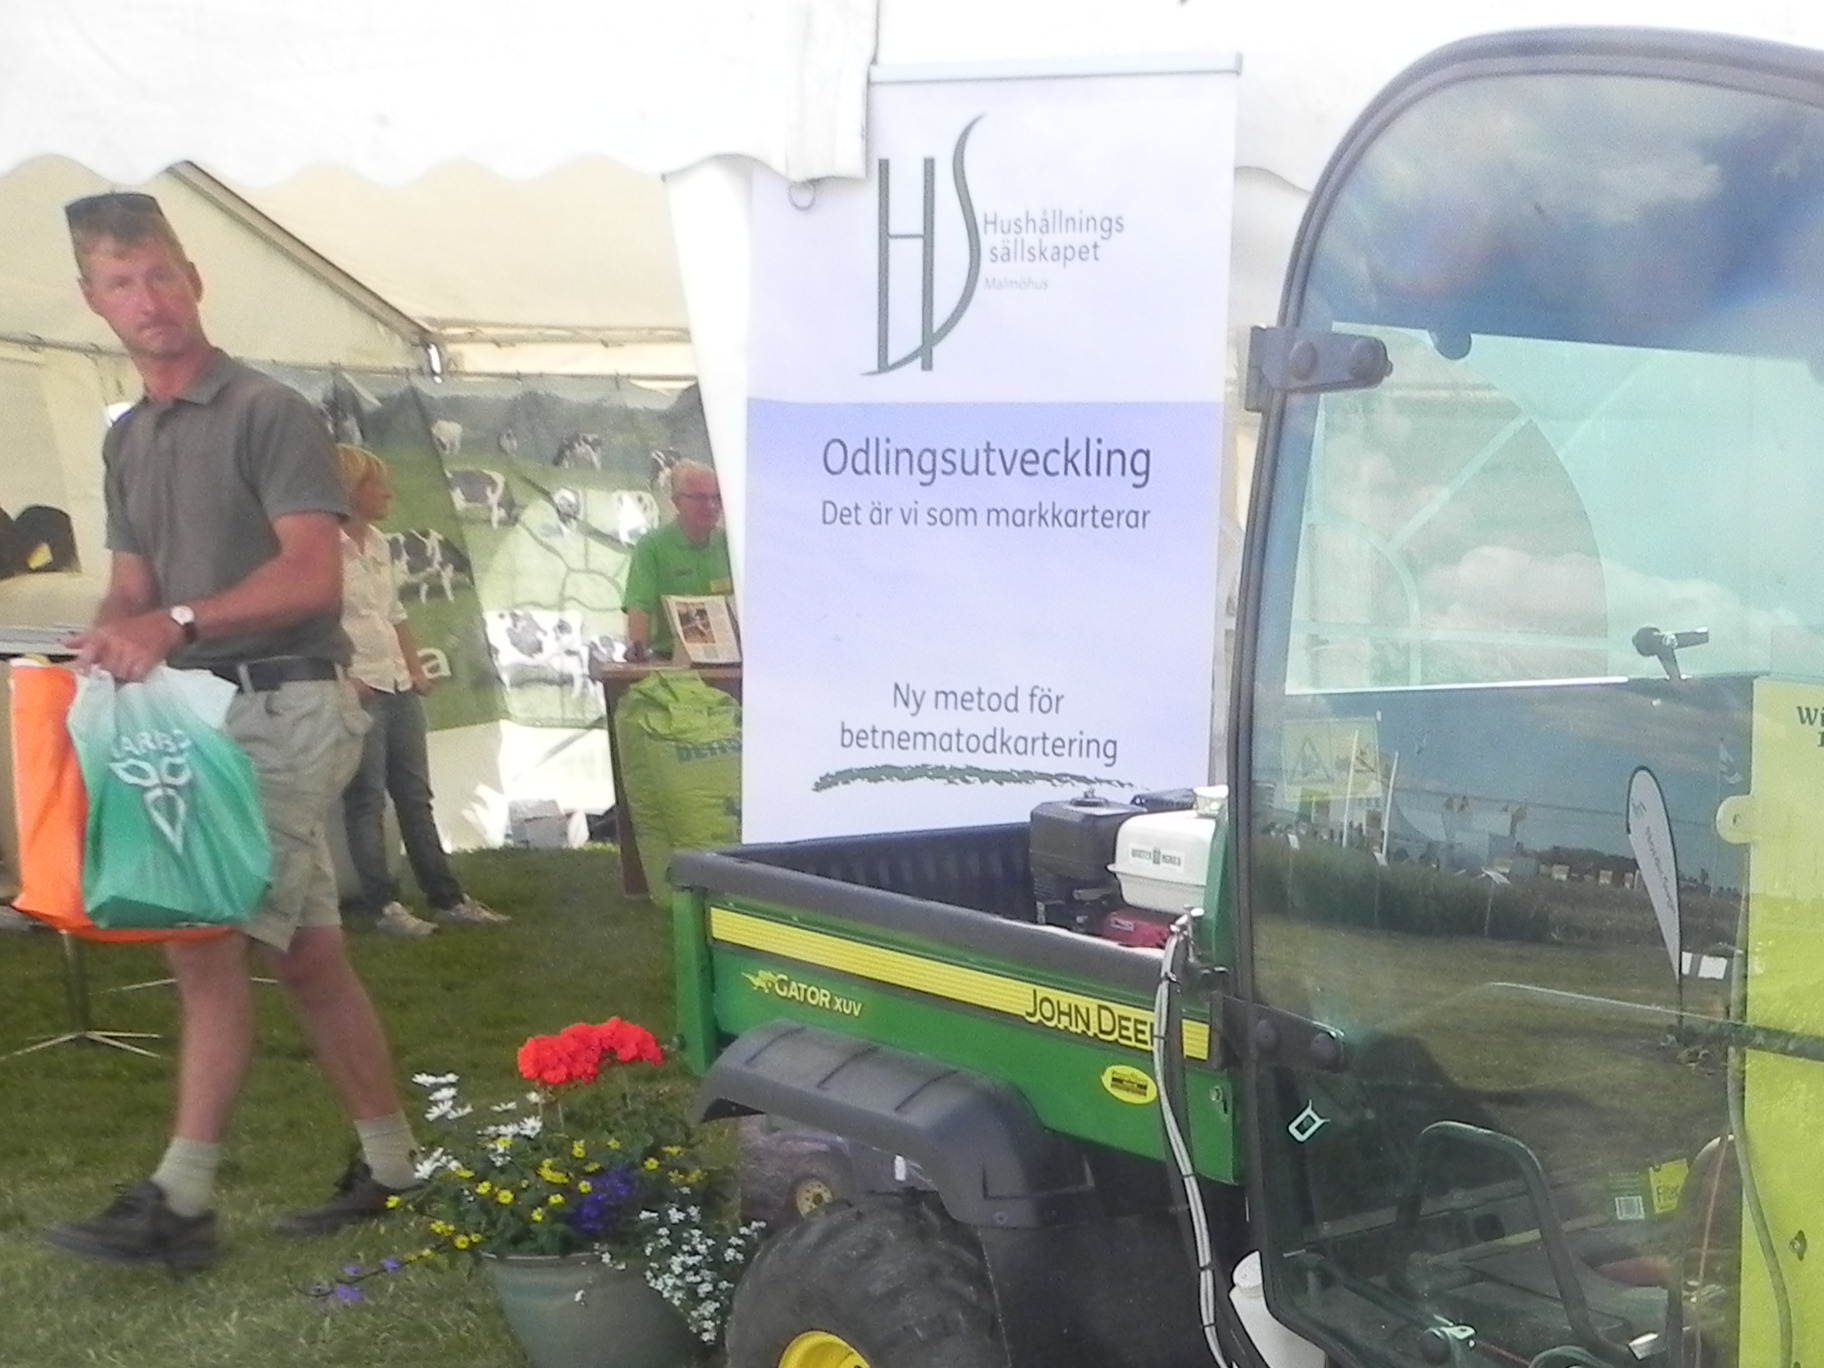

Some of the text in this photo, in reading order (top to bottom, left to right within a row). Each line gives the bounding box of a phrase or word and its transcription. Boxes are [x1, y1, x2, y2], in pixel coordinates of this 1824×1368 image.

[983, 208, 1125, 241] Hushållnings
[989, 237, 1101, 269] sällskapet
[822, 437, 1152, 488] Odlingsutveckling
[821, 500, 1152, 530] Det är vi som markkarterar
[893, 682, 1065, 716] Ny metod för
[840, 721, 1119, 768] betnematodkartering
[774, 973, 863, 1017] GATOR XUV
[1025, 989, 1155, 1046] JOHN DEE
